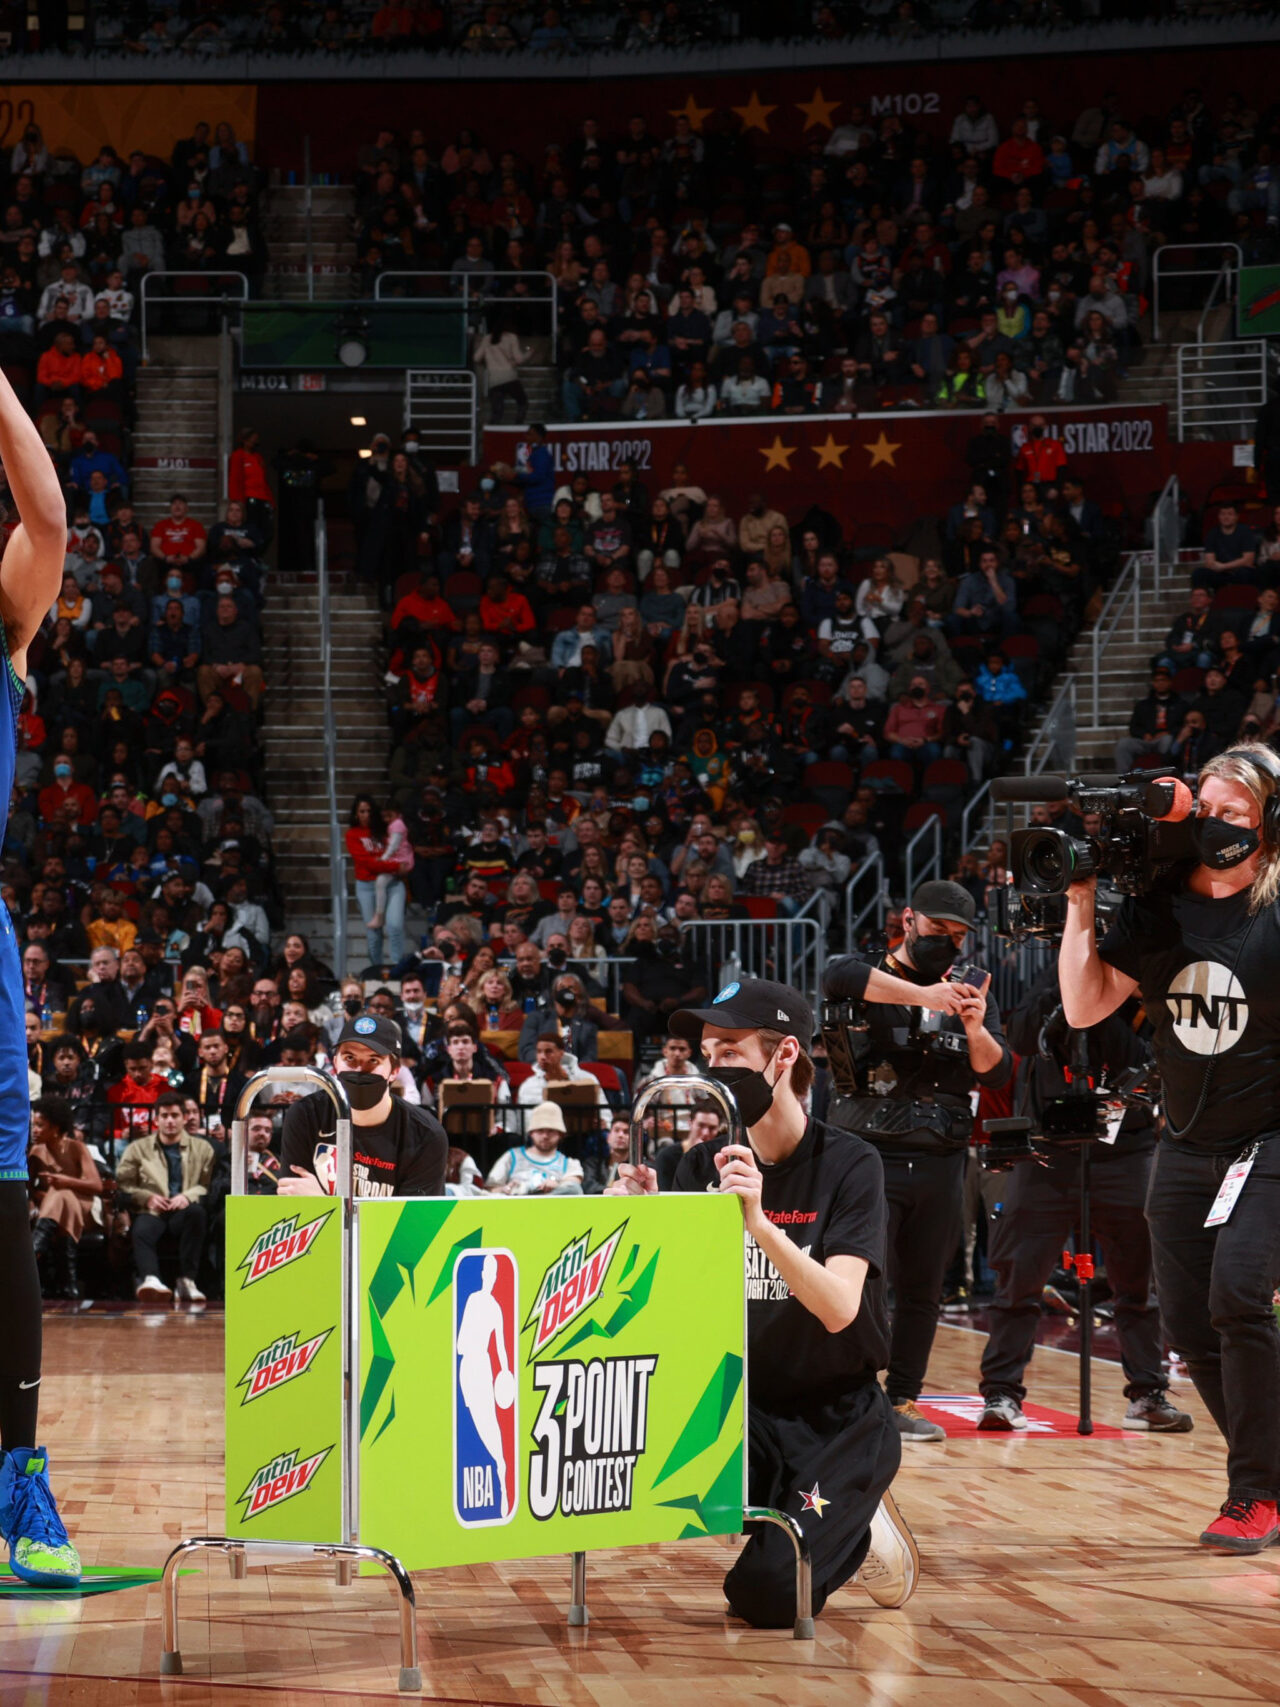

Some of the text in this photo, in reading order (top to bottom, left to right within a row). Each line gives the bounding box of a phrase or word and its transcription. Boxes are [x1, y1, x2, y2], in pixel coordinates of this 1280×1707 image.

[871, 92, 941, 117] M102
[241, 375, 288, 389] M101
[1063, 422, 1110, 454] STAR
[1111, 420, 1153, 451] 2022
[566, 441, 610, 471] STAR
[1166, 993, 1248, 1031] TNT
[564, 1358, 656, 1457] POINT
[463, 1464, 494, 1509] NBA
[561, 1455, 636, 1514] CONTEST
